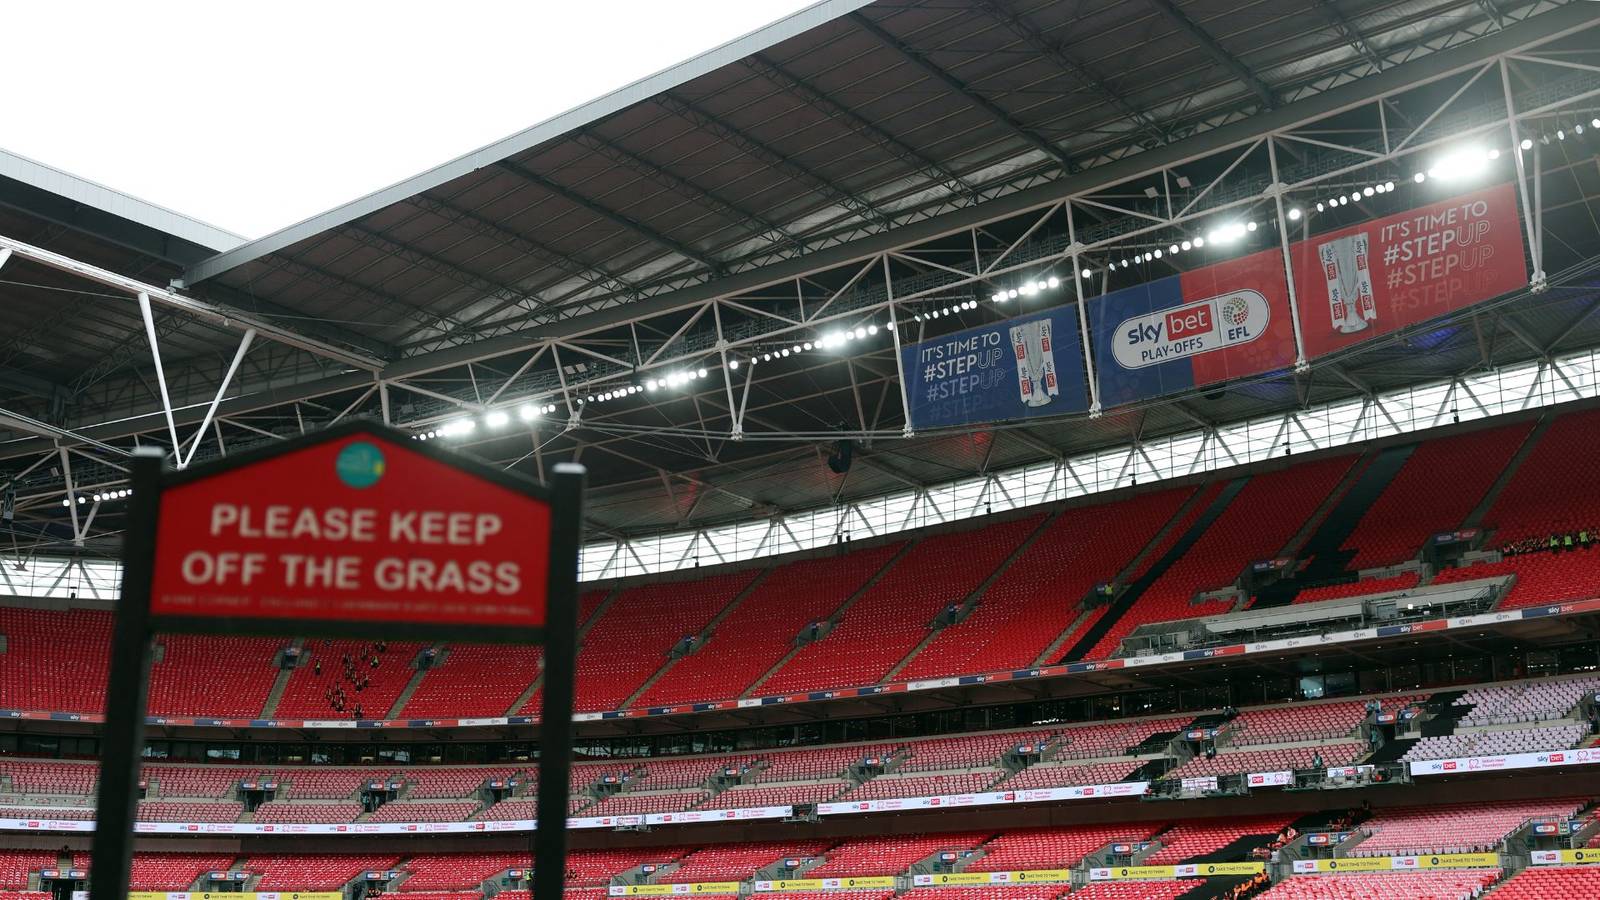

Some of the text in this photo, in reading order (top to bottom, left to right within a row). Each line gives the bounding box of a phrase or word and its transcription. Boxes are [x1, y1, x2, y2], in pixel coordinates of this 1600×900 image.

[1381, 200, 1488, 243] IT'S TIME TO
[1383, 220, 1491, 266] #STEPUP
[1387, 245, 1495, 290] #STEPUP
[1127, 310, 1208, 346] sky bet
[1228, 326, 1250, 340] EFL
[921, 331, 1000, 363] IT'S TIME TO
[1142, 337, 1204, 362] PLAY-OFFS
[923, 348, 1003, 382] #STEPUP
[927, 368, 1006, 402] #STEPUP
[210, 504, 503, 545] PLEASE KEEP
[181, 552, 522, 595] OFF THE GRASS
[1443, 762, 1456, 770] bet
[1550, 754, 1564, 762] bet
